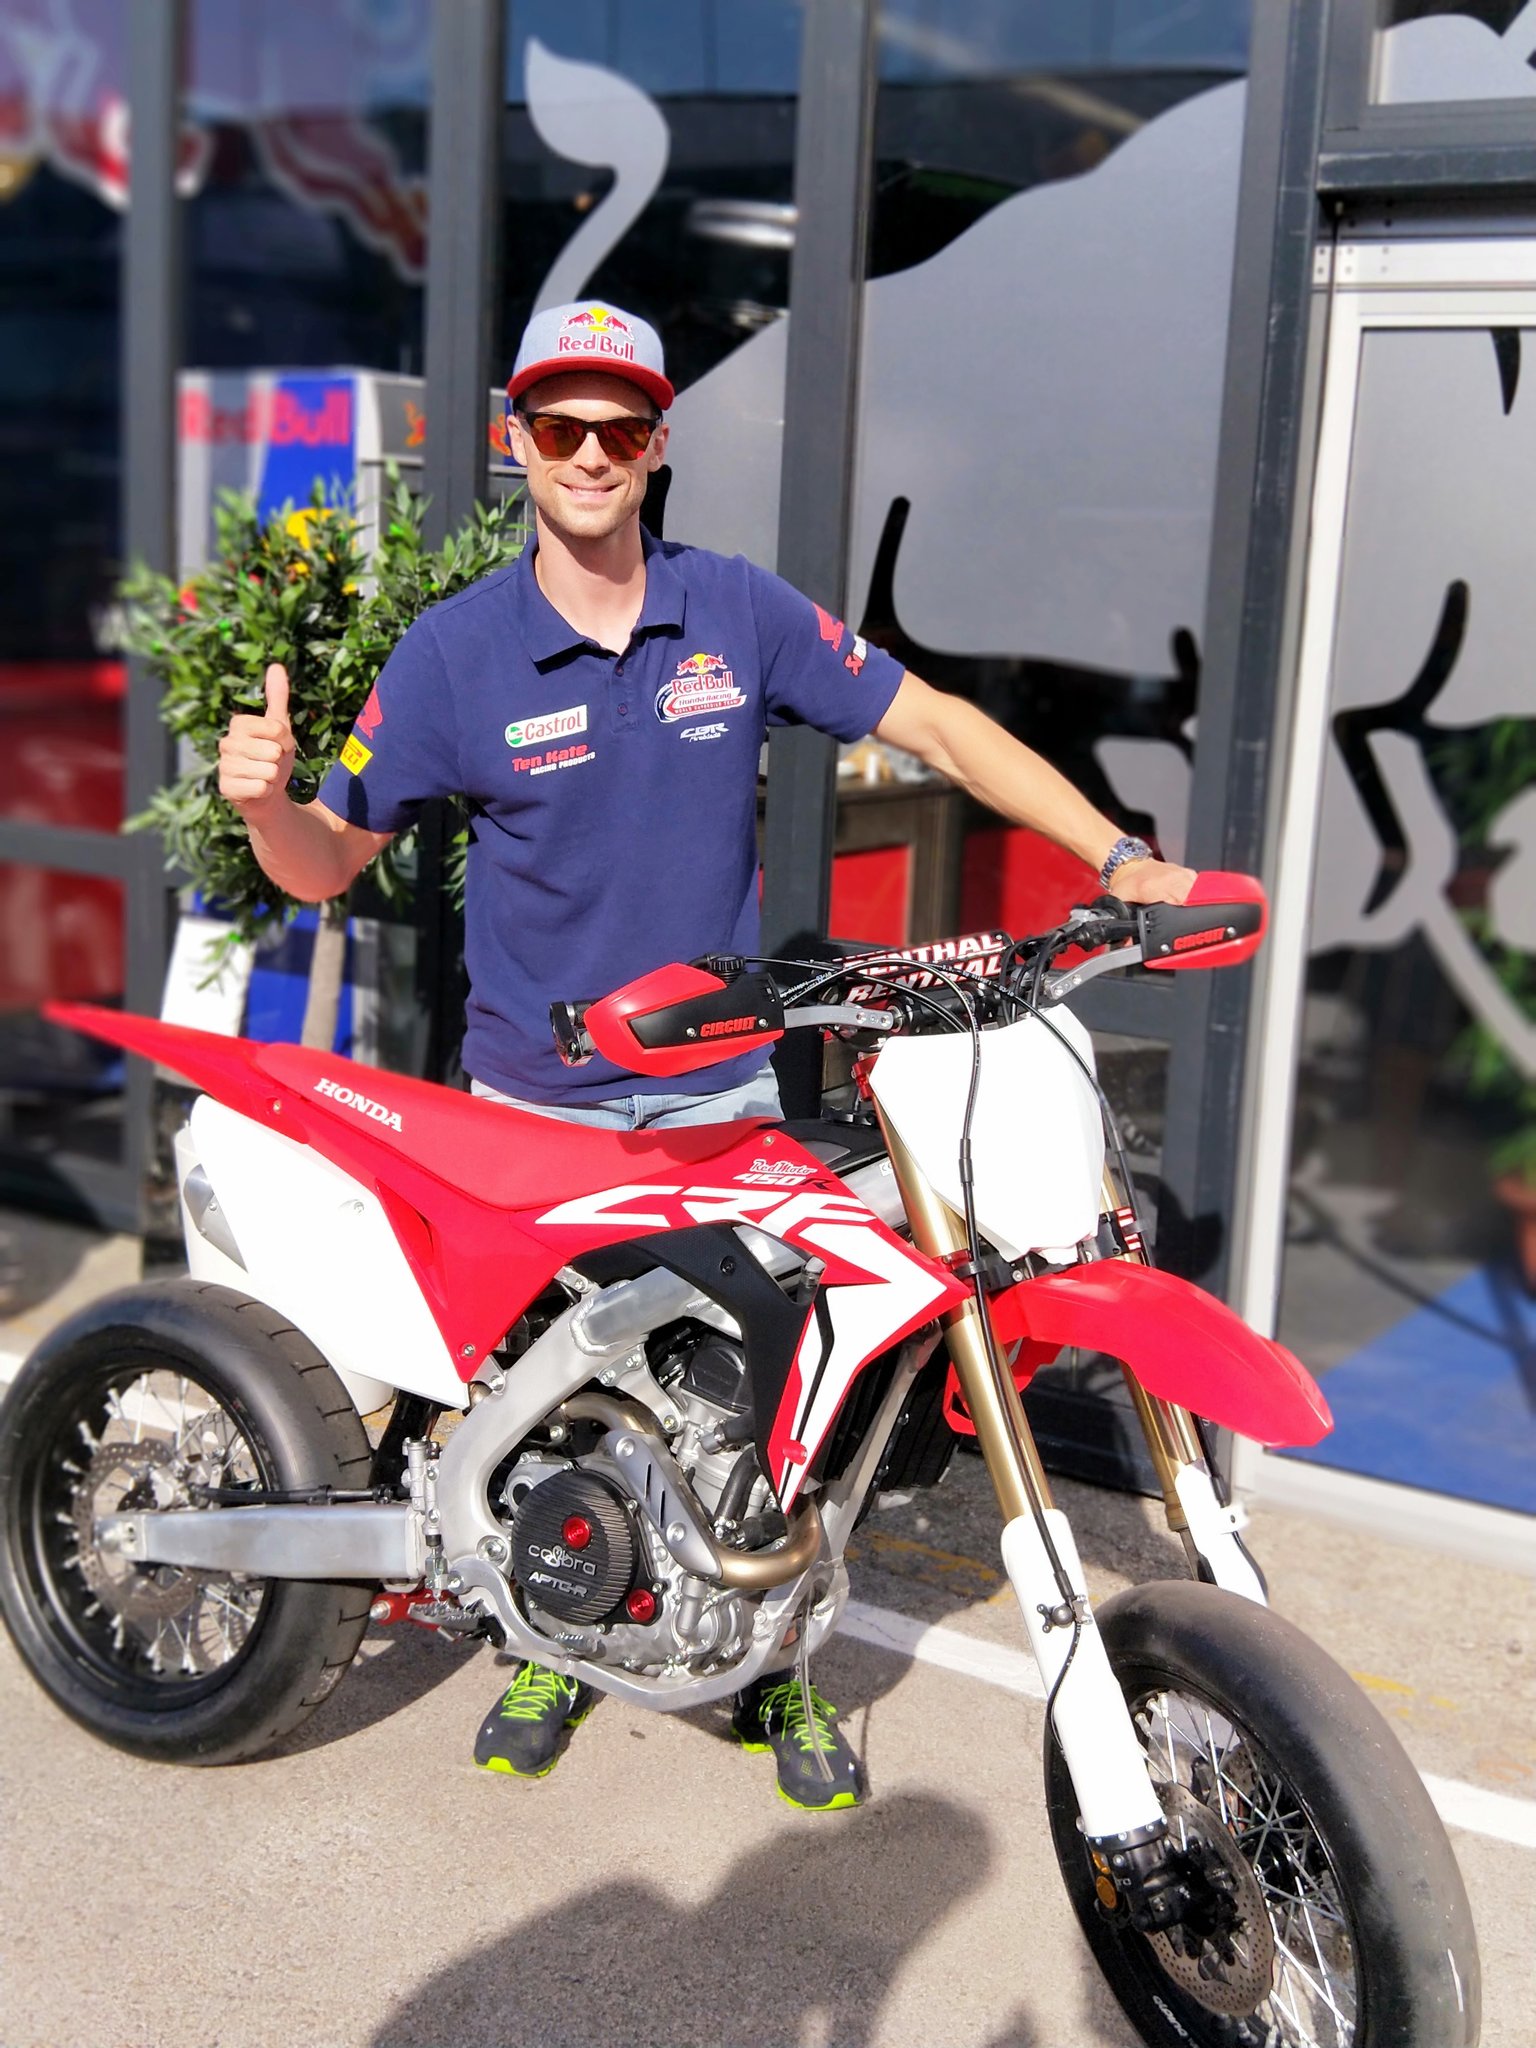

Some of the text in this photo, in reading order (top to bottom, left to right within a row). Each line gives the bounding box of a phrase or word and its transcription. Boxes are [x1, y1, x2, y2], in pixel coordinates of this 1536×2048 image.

[558, 333, 635, 361] Red Bull
[178, 387, 351, 446] Red Bull
[672, 671, 734, 695] Red Bull
[678, 692, 732, 706] Honda Racing
[525, 711, 582, 741] Castrol
[511, 743, 589, 772] Ten Kate
[530, 751, 596, 776] RACING PRODUCTS
[700, 1015, 758, 1038] CIRCUIT
[313, 1077, 403, 1133] HONDA
[535, 1184, 878, 1239] CRF
